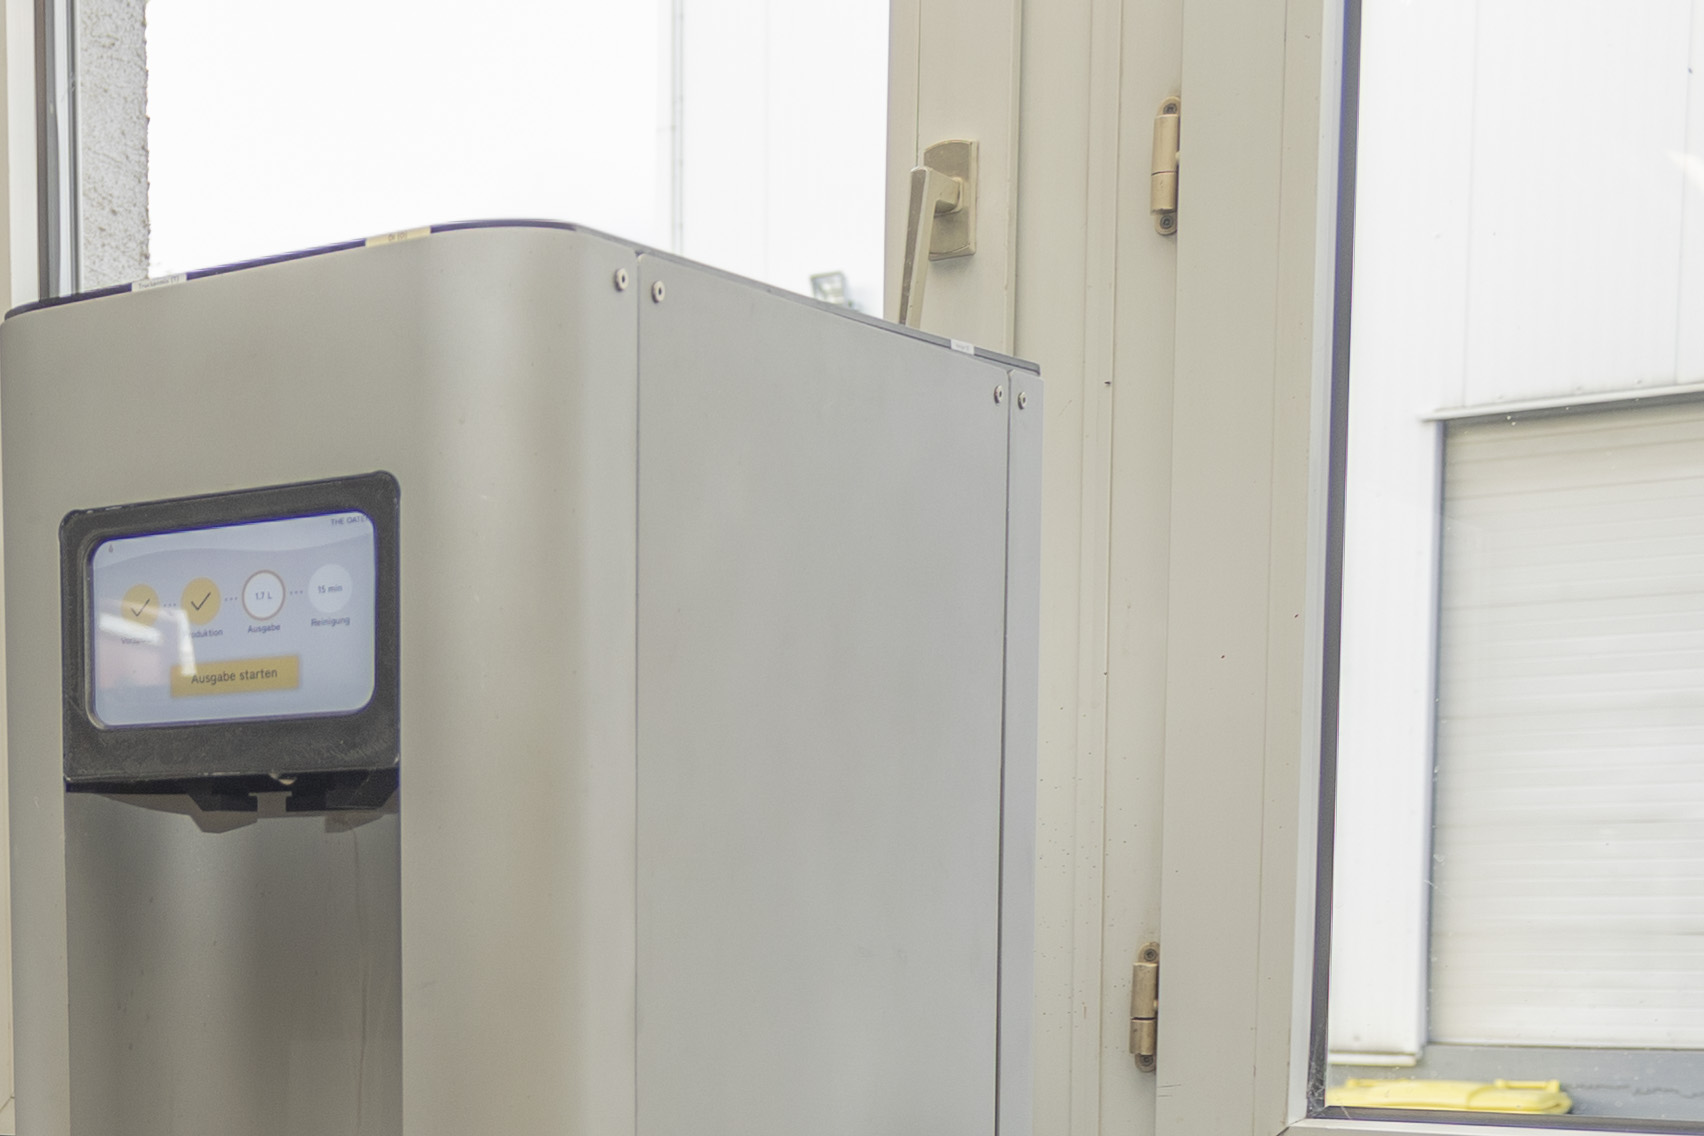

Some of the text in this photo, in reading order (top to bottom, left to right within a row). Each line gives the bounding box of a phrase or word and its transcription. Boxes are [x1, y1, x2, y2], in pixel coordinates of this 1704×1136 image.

[310, 617, 350, 628] Reinigung
[247, 624, 281, 634] Ausgabe
[191, 668, 278, 686] Ausgabe starten
